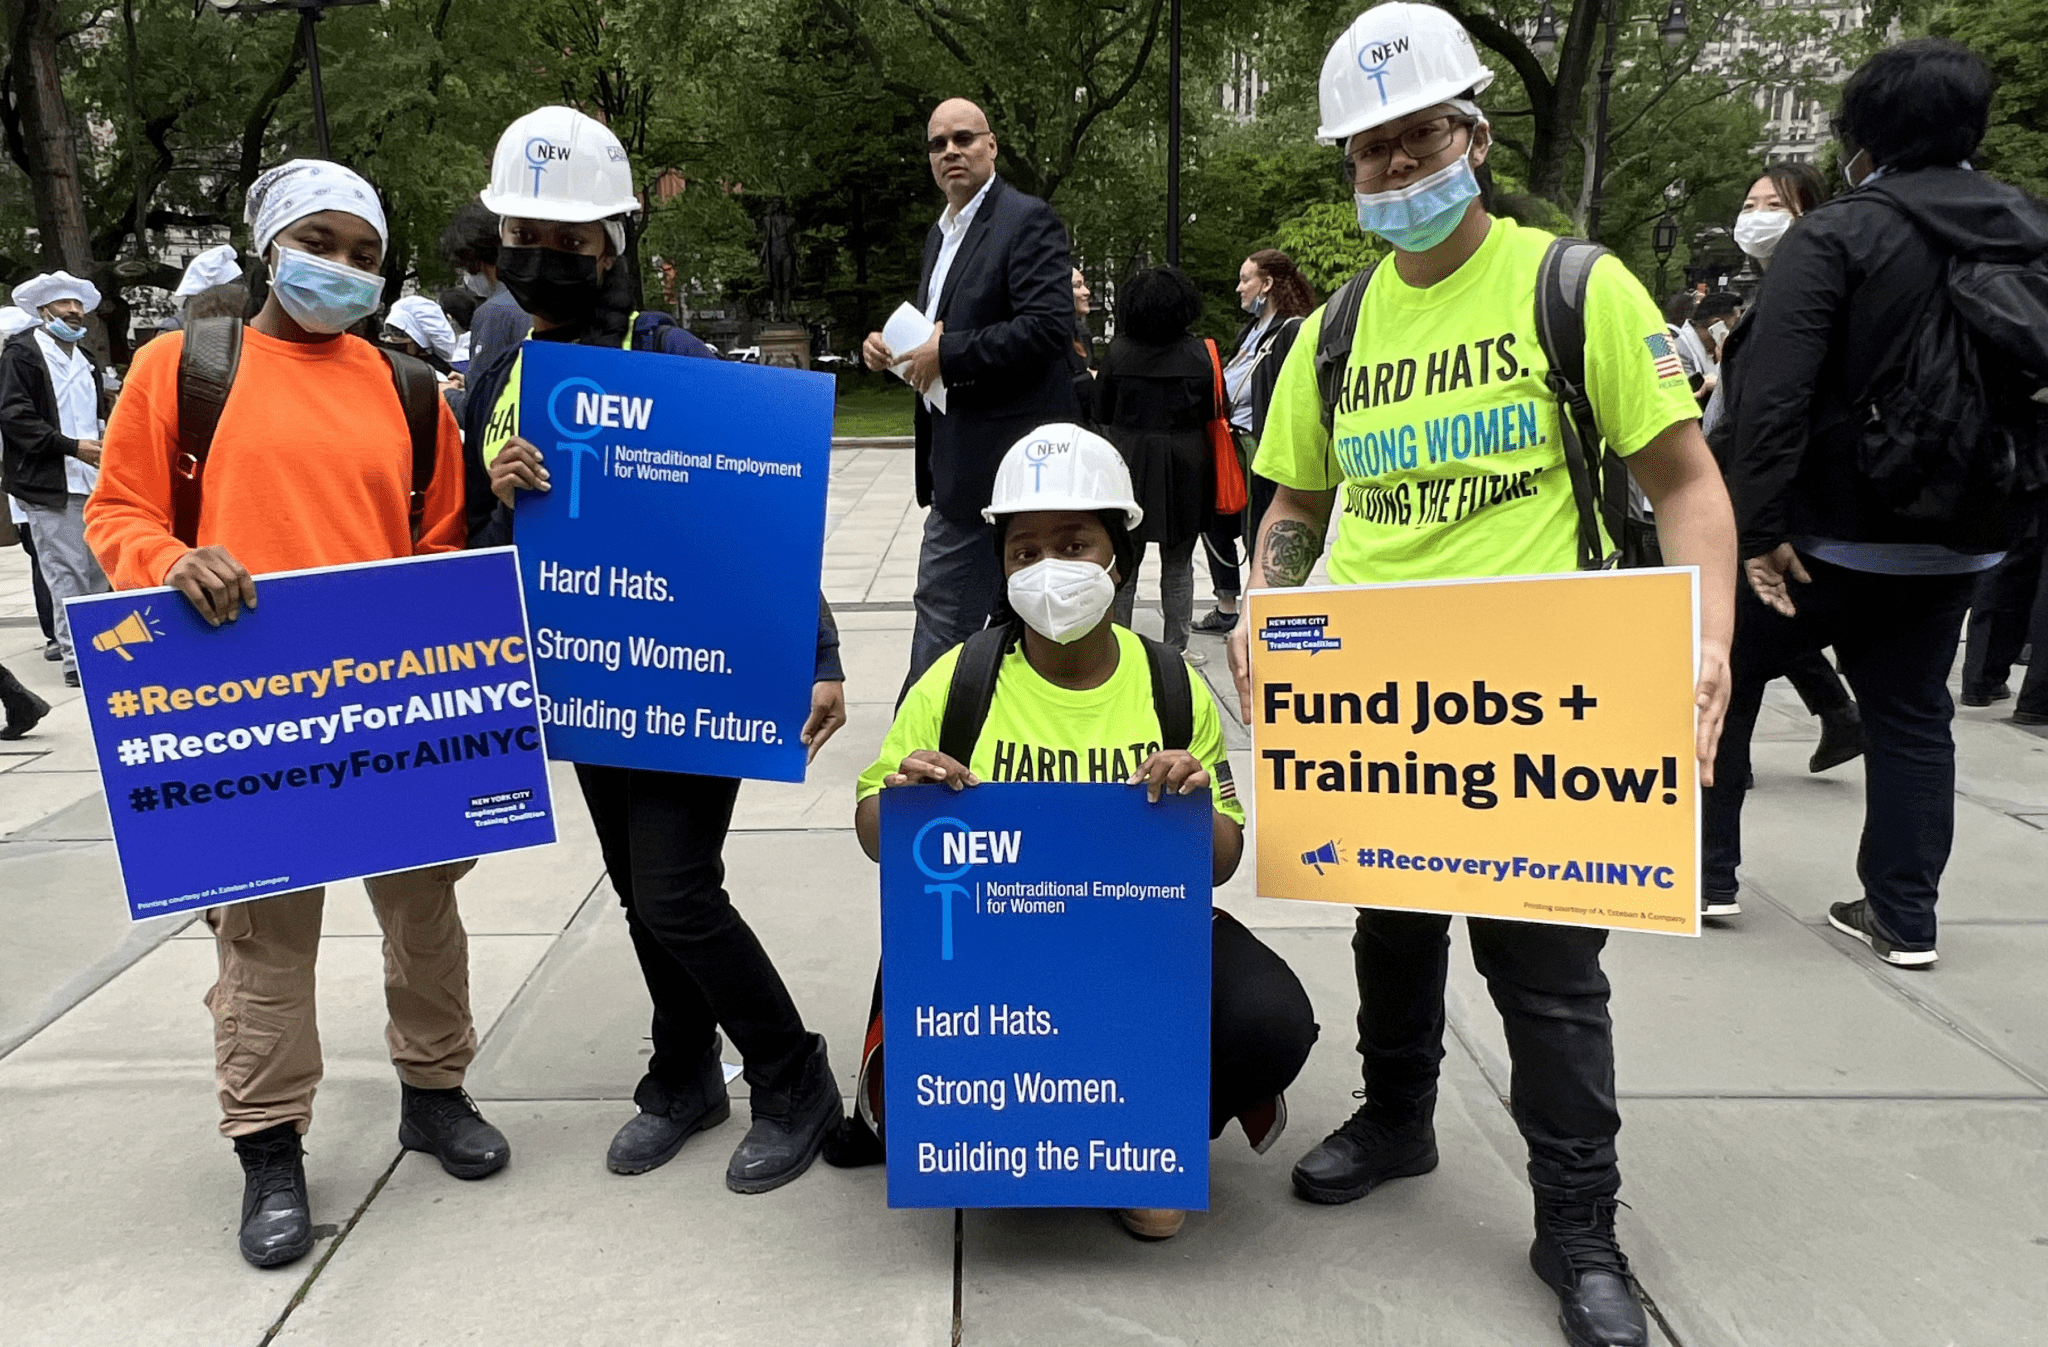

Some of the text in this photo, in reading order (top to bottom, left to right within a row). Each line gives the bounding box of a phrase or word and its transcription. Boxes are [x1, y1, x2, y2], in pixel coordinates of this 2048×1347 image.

[1371, 35, 1409, 64] NEW
[537, 144, 571, 161] NEW
[1339, 332, 1530, 415] HARD HATS.
[576, 392, 654, 430] NEW
[1037, 441, 1071, 456] NEW
[1338, 400, 1546, 479] STRONG WOMEN.
[614, 445, 802, 478] Nontraditional Employment
[614, 461, 690, 484] for Women
[1415, 477, 1456, 530] THE
[539, 560, 674, 602] Hard Hats.
[1308, 617, 1326, 625] CITY
[536, 628, 732, 674] Strong Women.
[106, 636, 527, 719] #RecoveryForAllNYC
[117, 680, 534, 767] #RecoveryForAllNYC
[538, 694, 783, 745] Building the Future.
[1263, 680, 1597, 735] Fund Jobs +
[128, 725, 540, 814] #RecoveryForAllNYC
[992, 739, 1078, 782] HARD
[1261, 749, 1677, 810] Training Now!
[512, 791, 531, 800] CITY
[943, 830, 1022, 865] NEW
[1357, 848, 1674, 889] #RecoveryForAllNYC
[986, 881, 1186, 901] Nontraditional Employment
[986, 898, 1065, 914] for Women
[916, 1003, 1059, 1037] Hard Hats.
[917, 1072, 1125, 1111] Strong Women.
[918, 1139, 1184, 1178] Building the Future.
